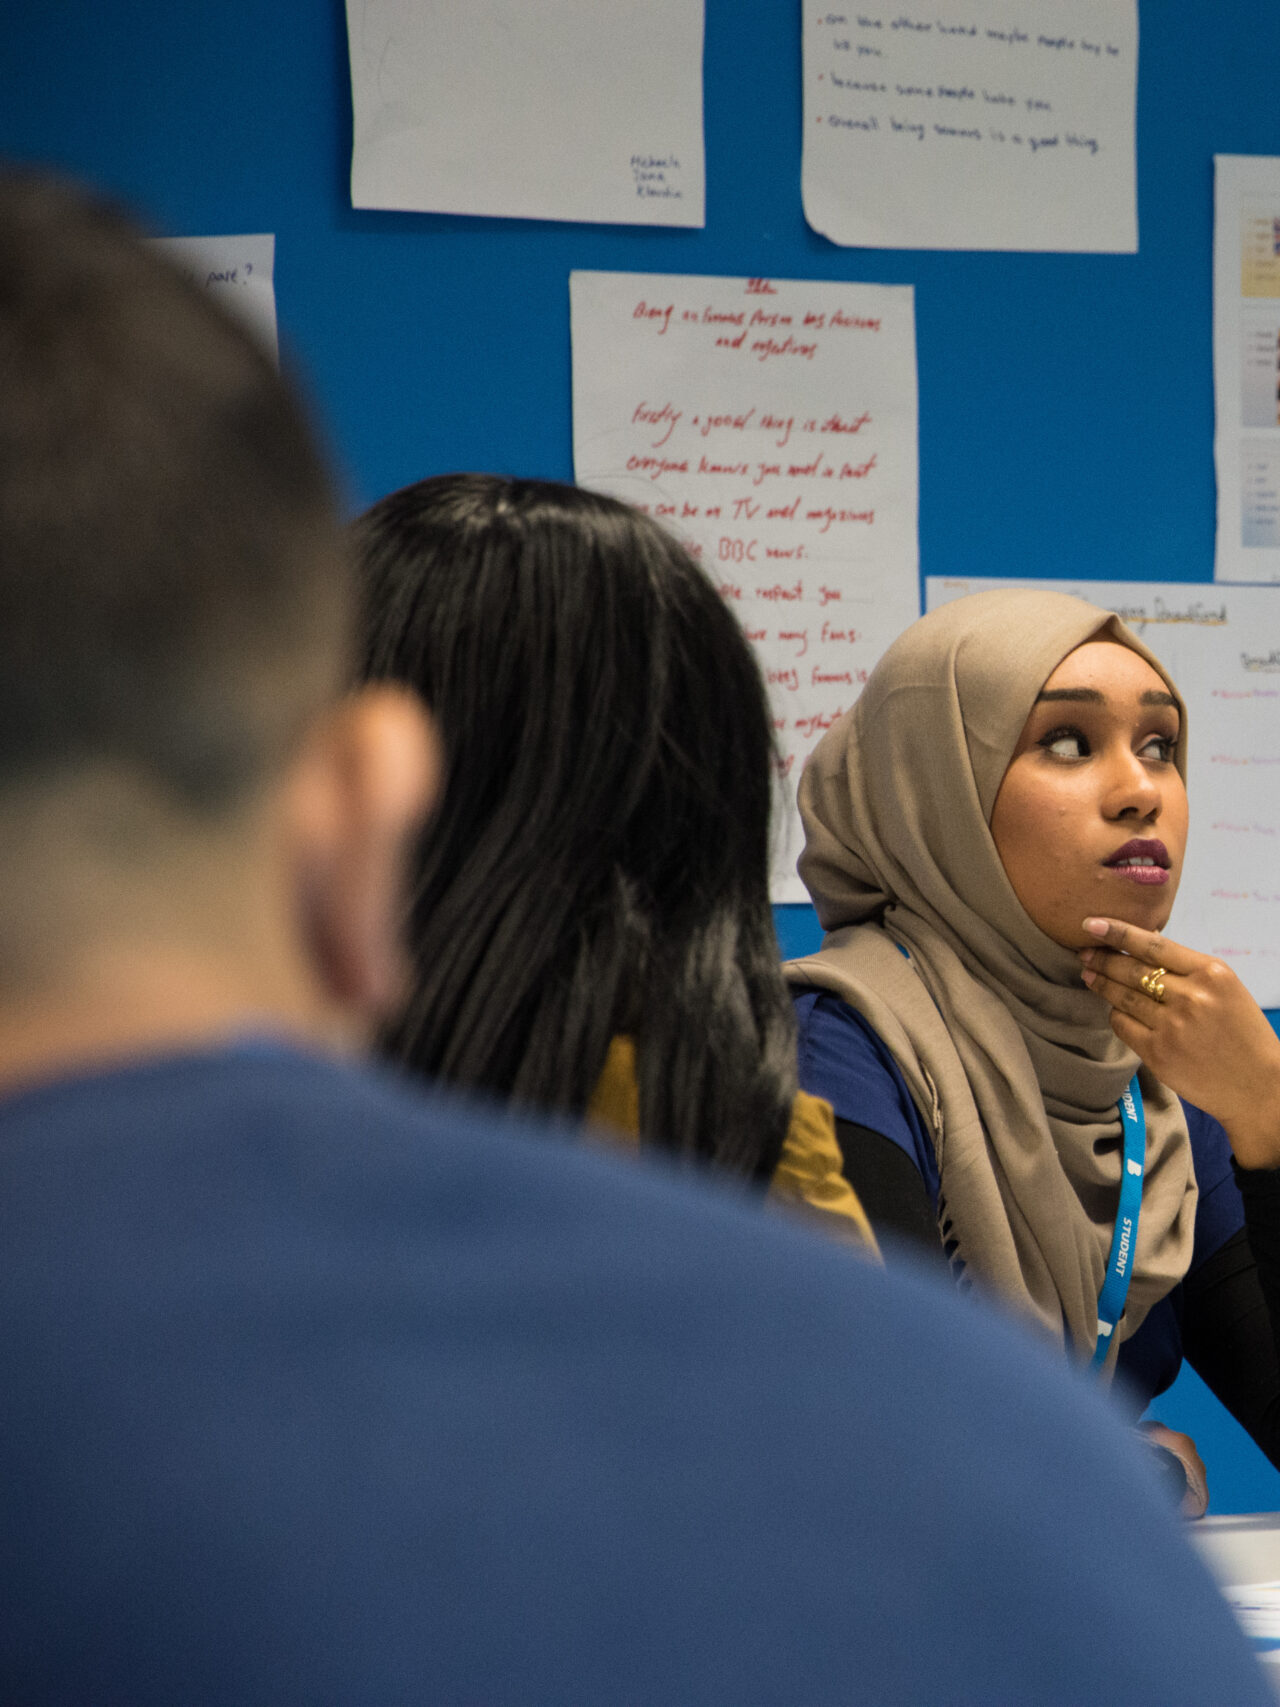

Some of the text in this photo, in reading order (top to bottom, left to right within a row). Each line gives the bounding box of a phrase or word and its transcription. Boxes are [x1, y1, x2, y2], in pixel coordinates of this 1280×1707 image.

[891, 16, 931, 30] other
[936, 19, 977, 36] hand
[890, 115, 925, 141] being
[714, 329, 748, 349] and
[700, 407, 756, 437] good
[759, 415, 794, 448] thing
[802, 418, 817, 433] is
[752, 462, 781, 487] you
[732, 496, 761, 521] TV
[766, 495, 802, 521] and
[718, 535, 758, 563] BBC
[817, 584, 842, 607] you
[778, 628, 809, 658] many
[1122, 1085, 1138, 1123] UDENT
[1115, 1217, 1132, 1278] STUDENT
